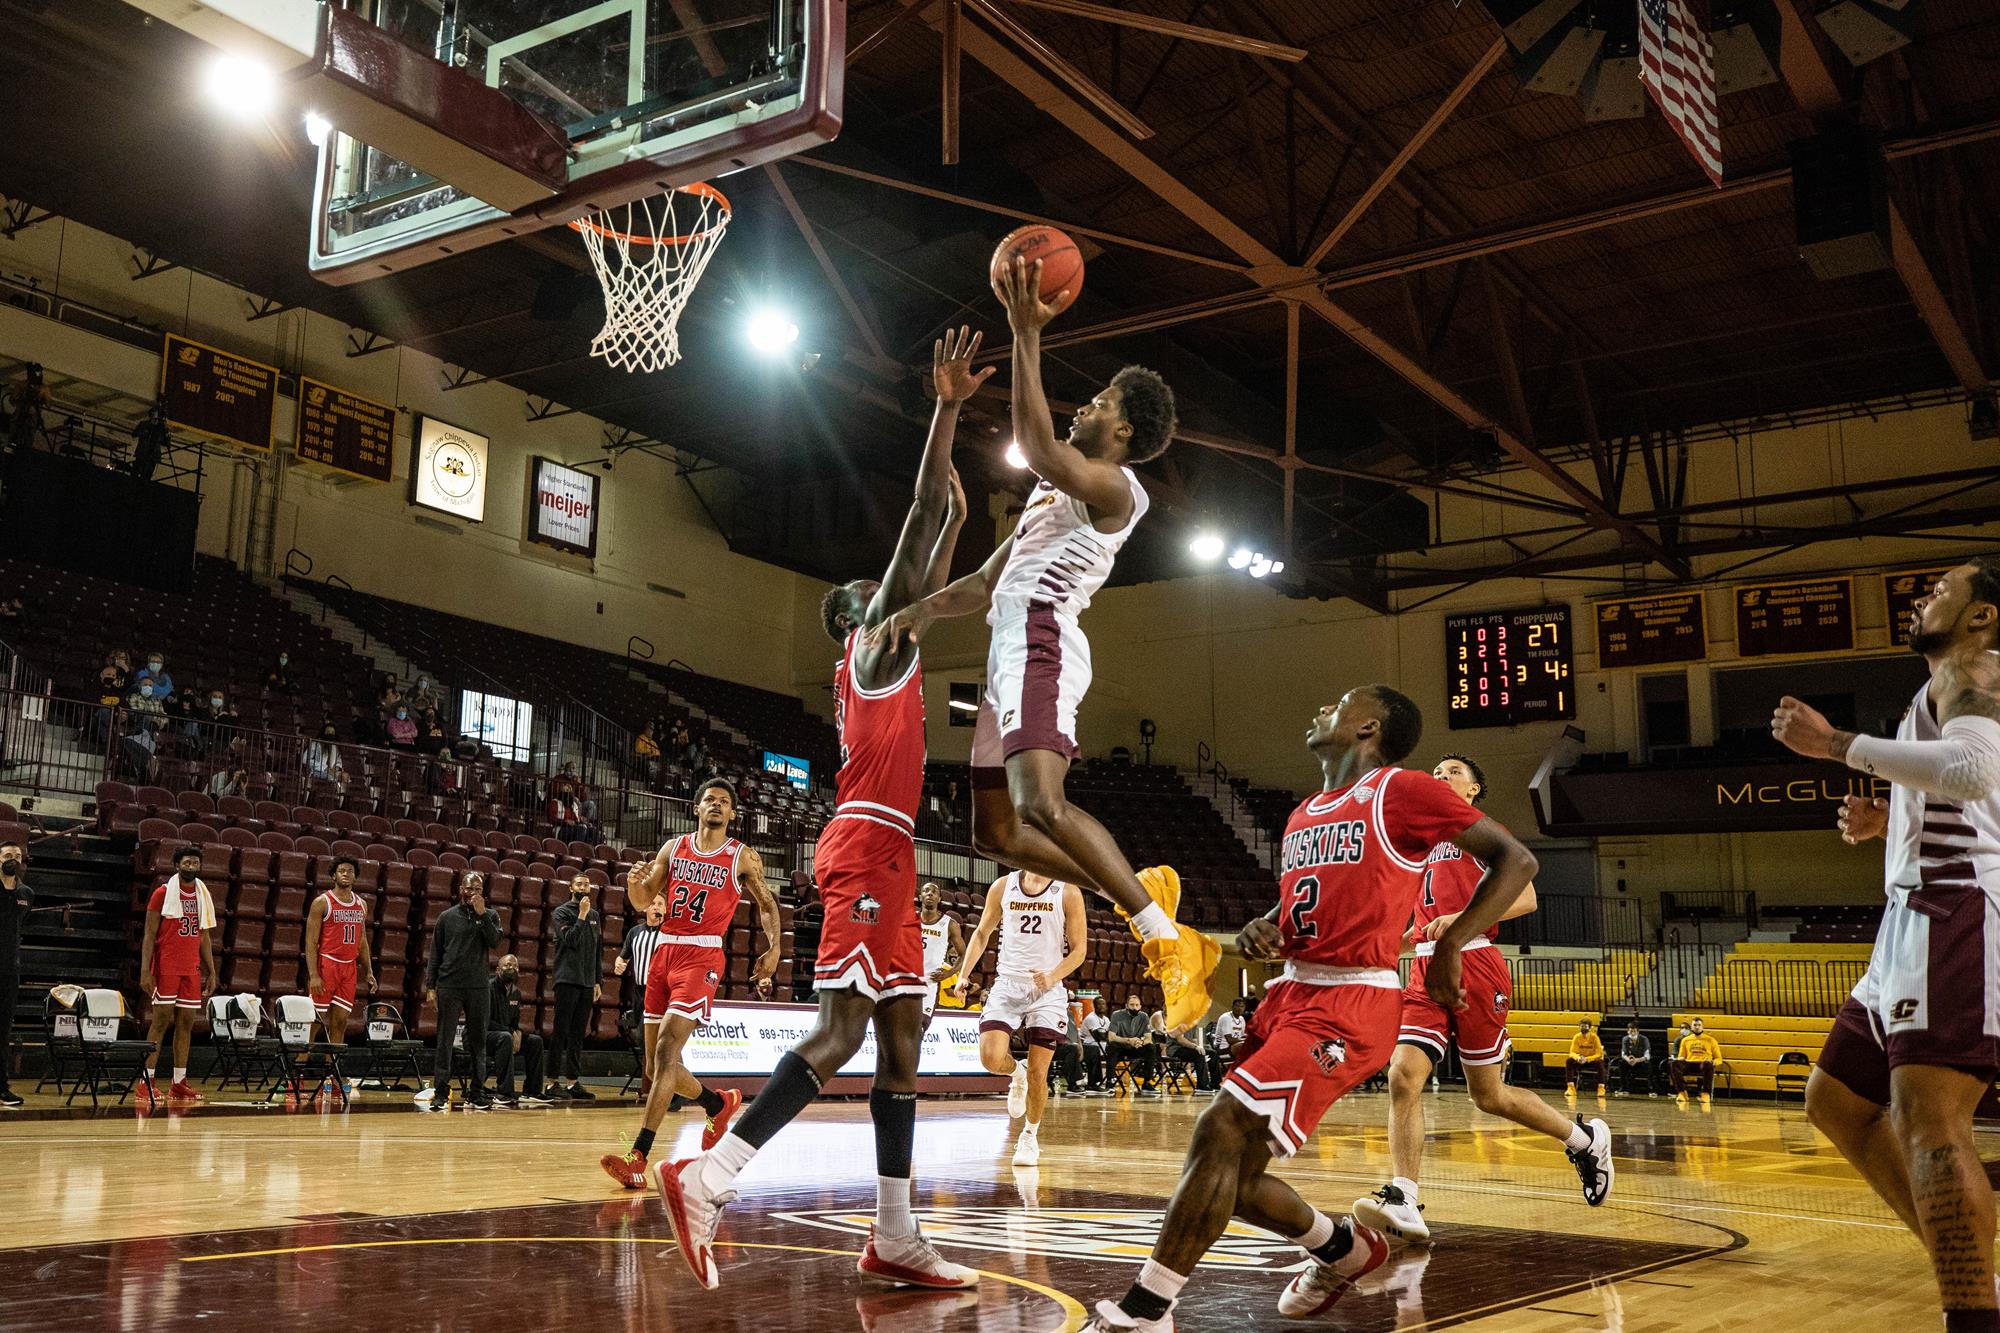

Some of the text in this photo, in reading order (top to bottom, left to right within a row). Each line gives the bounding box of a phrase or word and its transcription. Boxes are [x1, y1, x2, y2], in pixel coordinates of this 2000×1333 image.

[183, 381, 200, 393] 1987
[212, 366, 267, 390] MAC Tournament
[444, 431, 474, 453] Chippewa
[539, 490, 590, 518] meijer
[548, 518, 580, 533] Lower Prices
[1449, 615, 1503, 628] PLYR FLS PTS
[1513, 611, 1565, 626] CHIPPEWAS
[1462, 626, 1506, 643] 1 0 3
[1528, 623, 1558, 648] 27
[1459, 643, 1507, 660] 3 2 2
[1538, 648, 1560, 657] FOULS
[1459, 659, 1508, 675] 4 1 7
[1516, 664, 1527, 683] 3
[1545, 660, 1559, 681] 4
[1459, 675, 1508, 692] 5 0 7
[1451, 691, 1509, 709] 22 0 3
[1558, 691, 1563, 711] 1
[672, 858, 729, 889] HUSKIES
[1424, 868, 1436, 907] 1
[670, 885, 709, 924] 24
[1009, 900, 1054, 912] CHIPPEWAS
[1290, 875, 1321, 939] 2
[179, 916, 199, 937] 32
[1020, 914, 1043, 934] 22
[343, 924, 356, 944] 11
[234, 1020, 251, 1028] NIU
[285, 1022, 303, 1030] NIU
[371, 1023, 387, 1032] NIU
